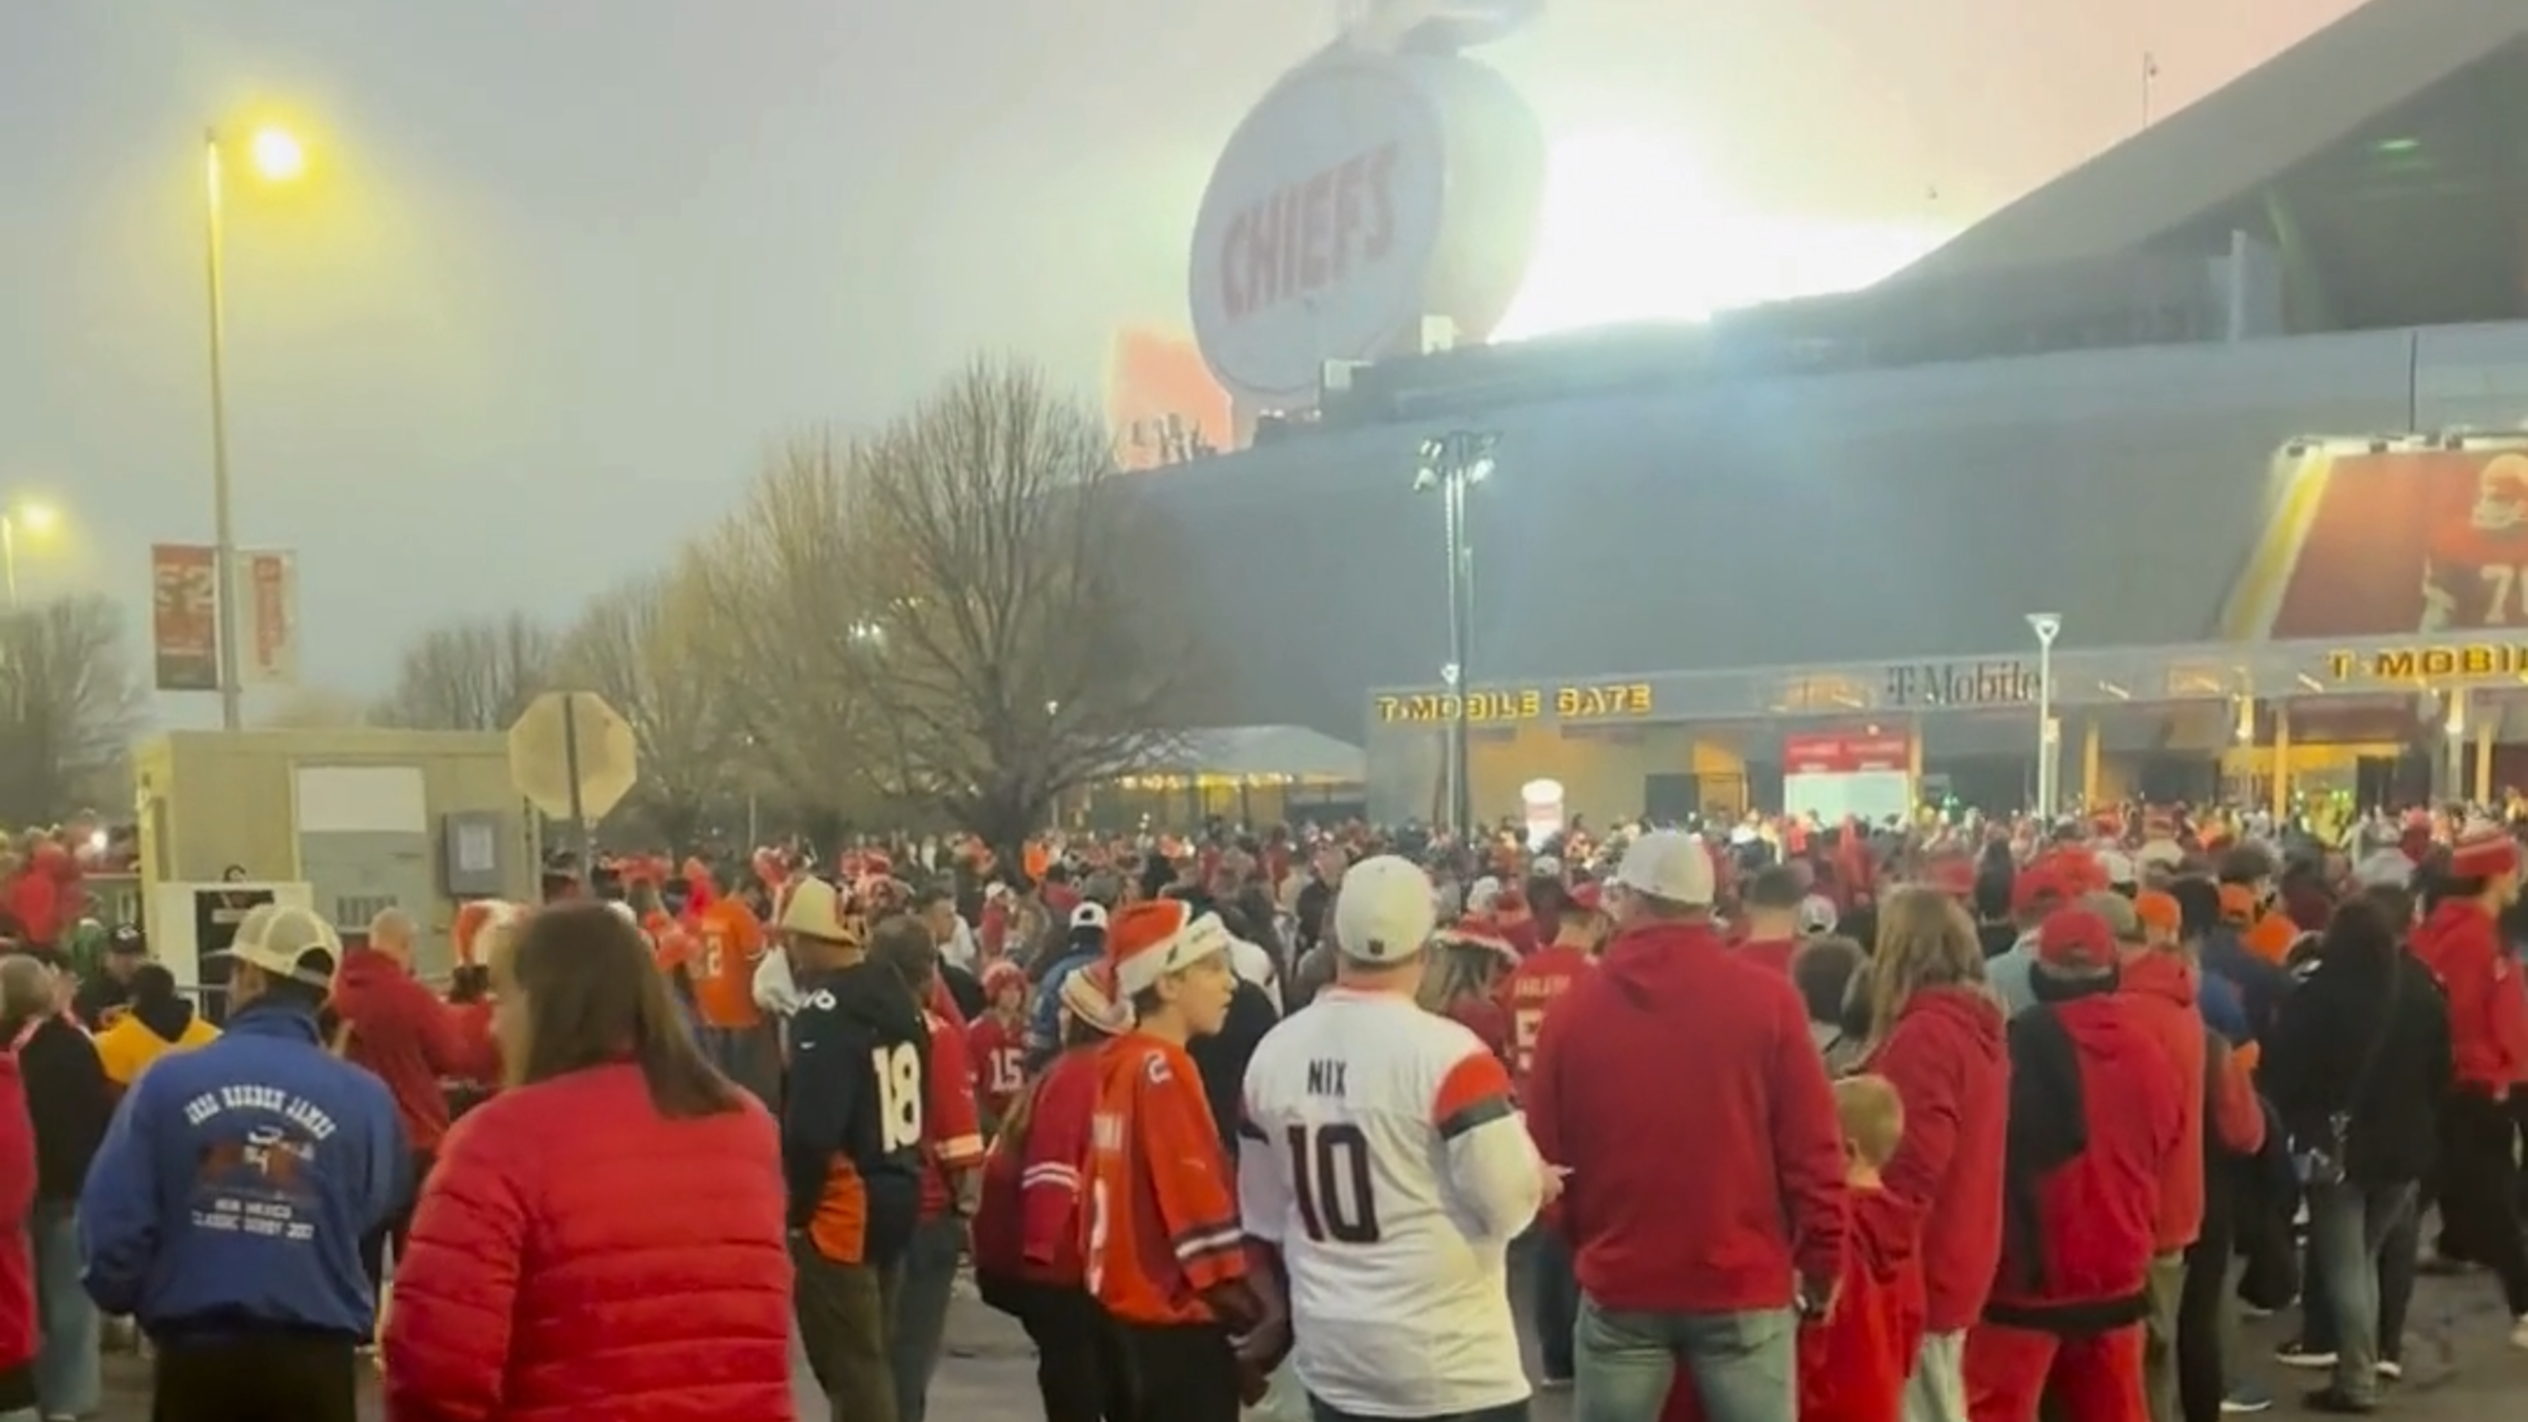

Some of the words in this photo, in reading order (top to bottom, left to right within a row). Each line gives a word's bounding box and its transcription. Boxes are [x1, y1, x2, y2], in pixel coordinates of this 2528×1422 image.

[1221, 139, 1398, 321] CHIEFS
[2480, 564, 2528, 624] 7
[1557, 682, 1651, 718] GATE
[870, 1040, 922, 1154] 18
[989, 1047, 1024, 1093] 15
[1307, 1059, 1347, 1097] NIX
[1287, 1123, 1381, 1244] 10
